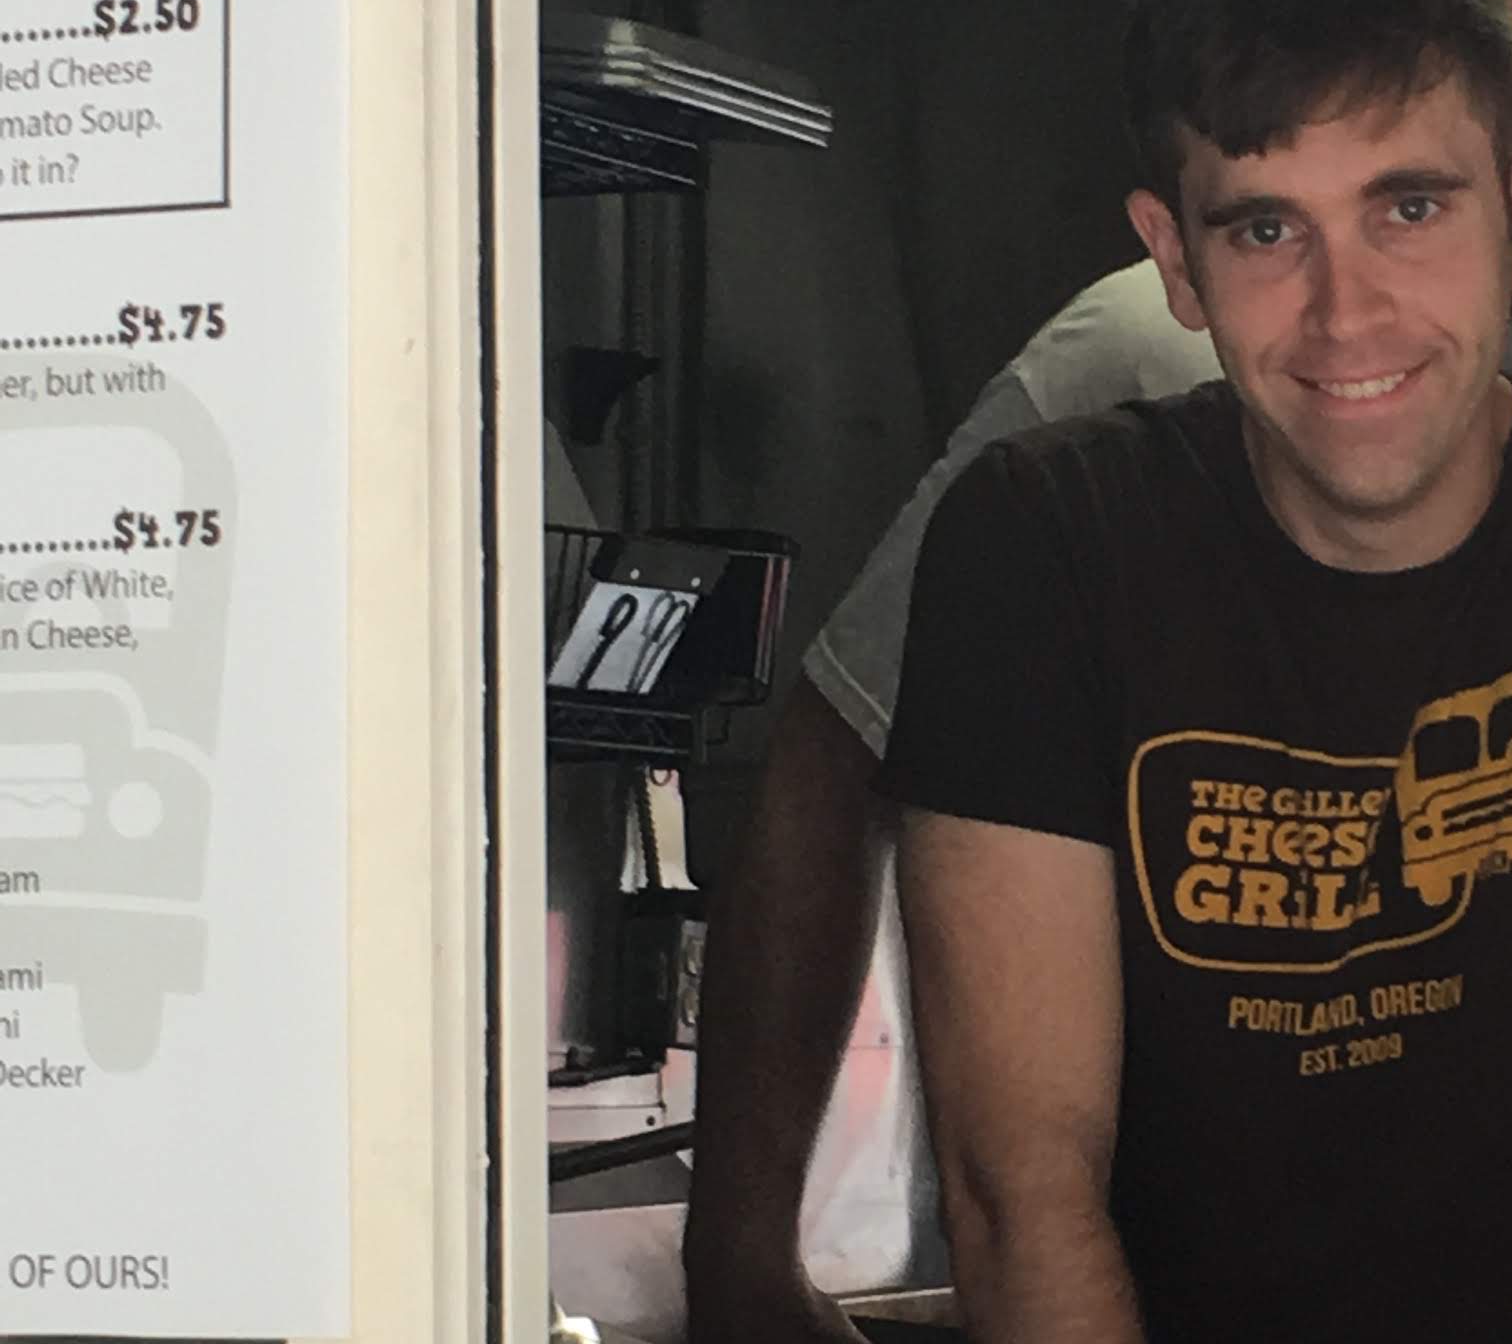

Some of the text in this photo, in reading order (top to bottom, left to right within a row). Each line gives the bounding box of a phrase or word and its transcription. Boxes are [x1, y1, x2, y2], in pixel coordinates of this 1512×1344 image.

[48, 56, 153, 89] Cheese
[80, 103, 162, 138] Soup.
[11, 153, 79, 187] it in?
[45, 366, 98, 398] but
[103, 361, 166, 395] with
[45, 571, 77, 600] of
[82, 569, 174, 602] White,
[26, 619, 139, 652] Cheese,
[1300, 1044, 1344, 1076] EST.
[9, 1254, 169, 1291] OF OURS!
